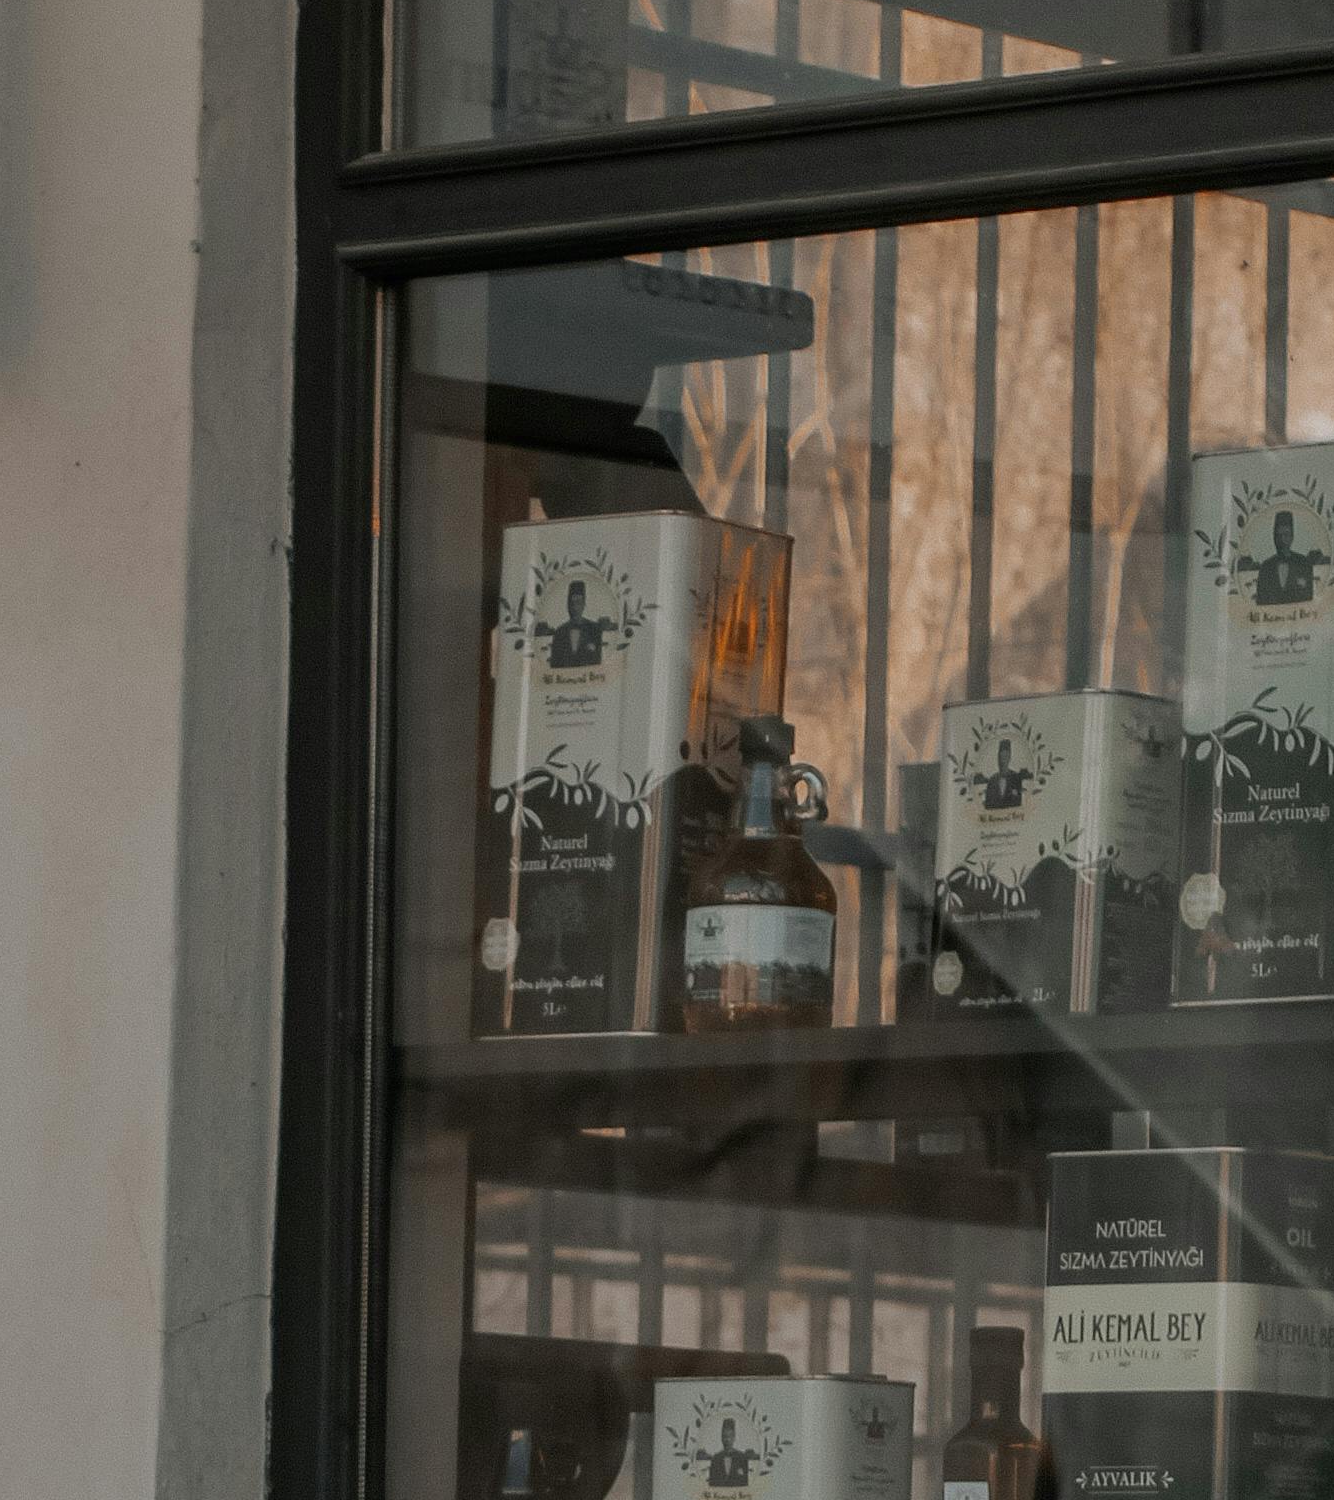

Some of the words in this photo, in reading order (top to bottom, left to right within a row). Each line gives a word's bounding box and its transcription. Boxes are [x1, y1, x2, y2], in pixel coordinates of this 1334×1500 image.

[1092, 1309, 1161, 1346] KEMAL
[1166, 1311, 1207, 1343] BEY
[1092, 1469, 1157, 1488] AYVALIK
